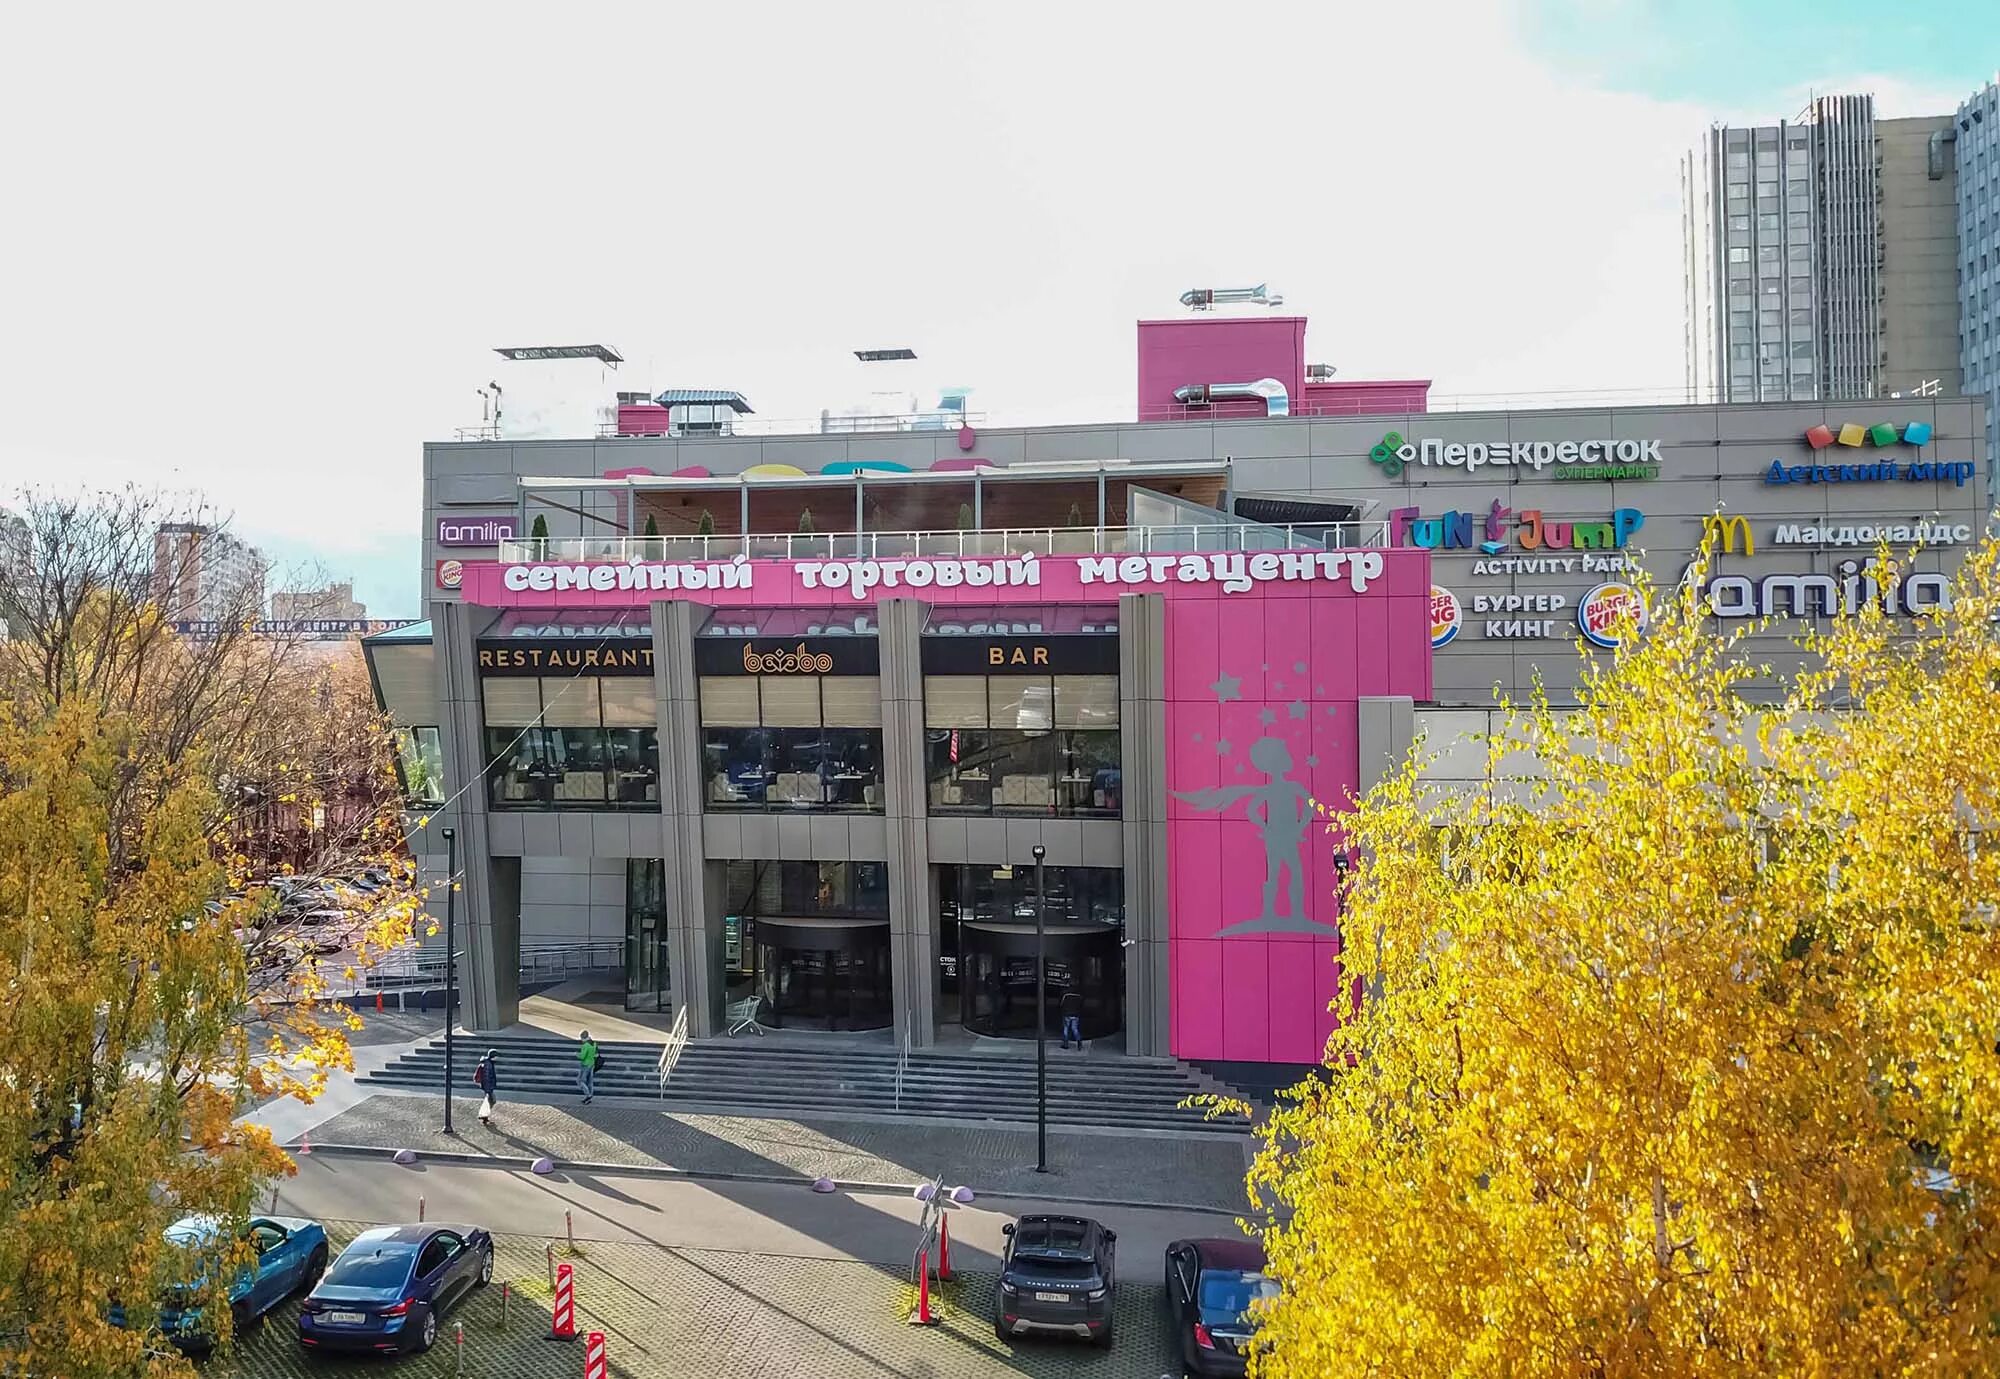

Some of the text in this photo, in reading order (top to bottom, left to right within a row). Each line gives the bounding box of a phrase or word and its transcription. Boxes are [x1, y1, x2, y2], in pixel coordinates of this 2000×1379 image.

[1420, 438, 1664, 472] Перекресток
[1554, 464, 1661, 480] СУПЕРМАРКЕТ
[1764, 458, 1976, 487] Детский мир
[439, 521, 512, 541] familia
[1774, 523, 1971, 545] Макдоналдс
[504, 551, 1383, 599] семейный торговый мегацентр
[1472, 555, 1639, 575] ACTIVITY PARK
[1473, 594, 1566, 613] БУРГЕР
[1586, 593, 1638, 617] BURG
[1485, 620, 1556, 637] КИНГ
[479, 649, 655, 667] RESTAURANT
[989, 647, 1049, 665] BAR
